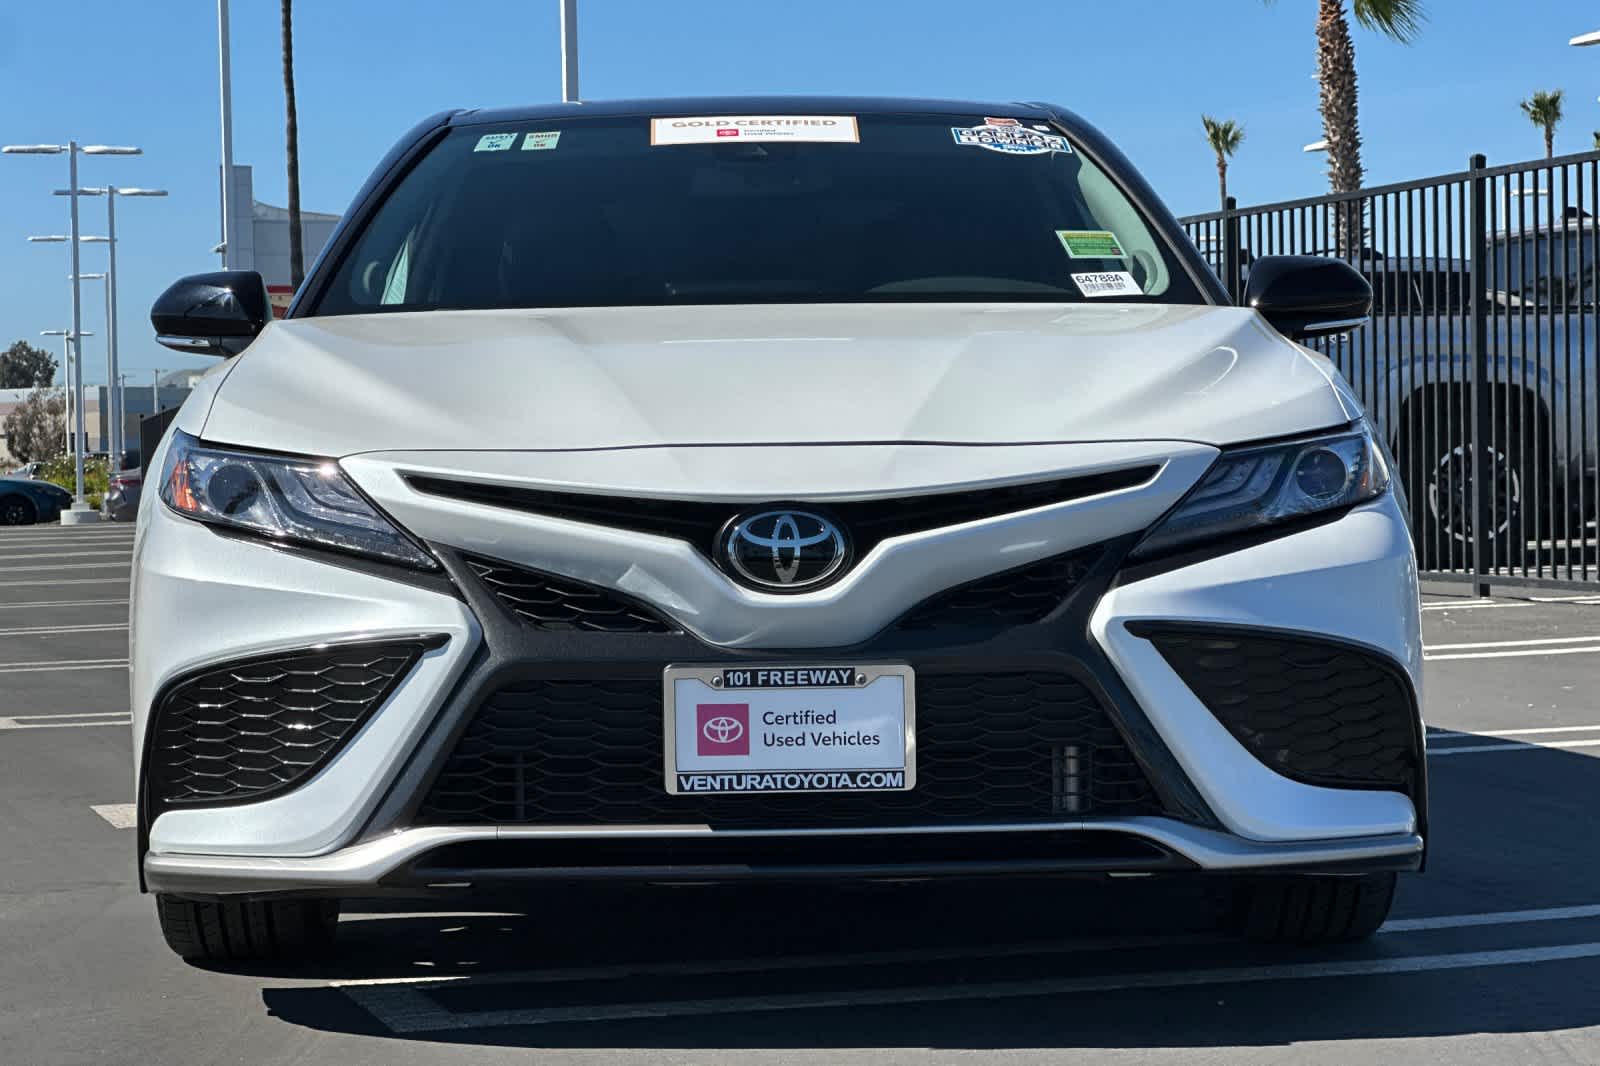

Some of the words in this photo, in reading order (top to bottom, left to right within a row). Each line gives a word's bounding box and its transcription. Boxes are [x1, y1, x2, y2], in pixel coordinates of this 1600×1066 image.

[672, 120, 730, 128] GOLD
[734, 119, 837, 127] CERTIFIED
[1075, 274, 1125, 284] 64788A
[726, 671, 751, 686] 101
[757, 670, 851, 686] FREEWAY
[762, 709, 837, 726] Certified
[763, 732, 806, 747] Used
[810, 731, 881, 747] Vehicles
[679, 772, 903, 791] VENTURATOYOTA.COM
